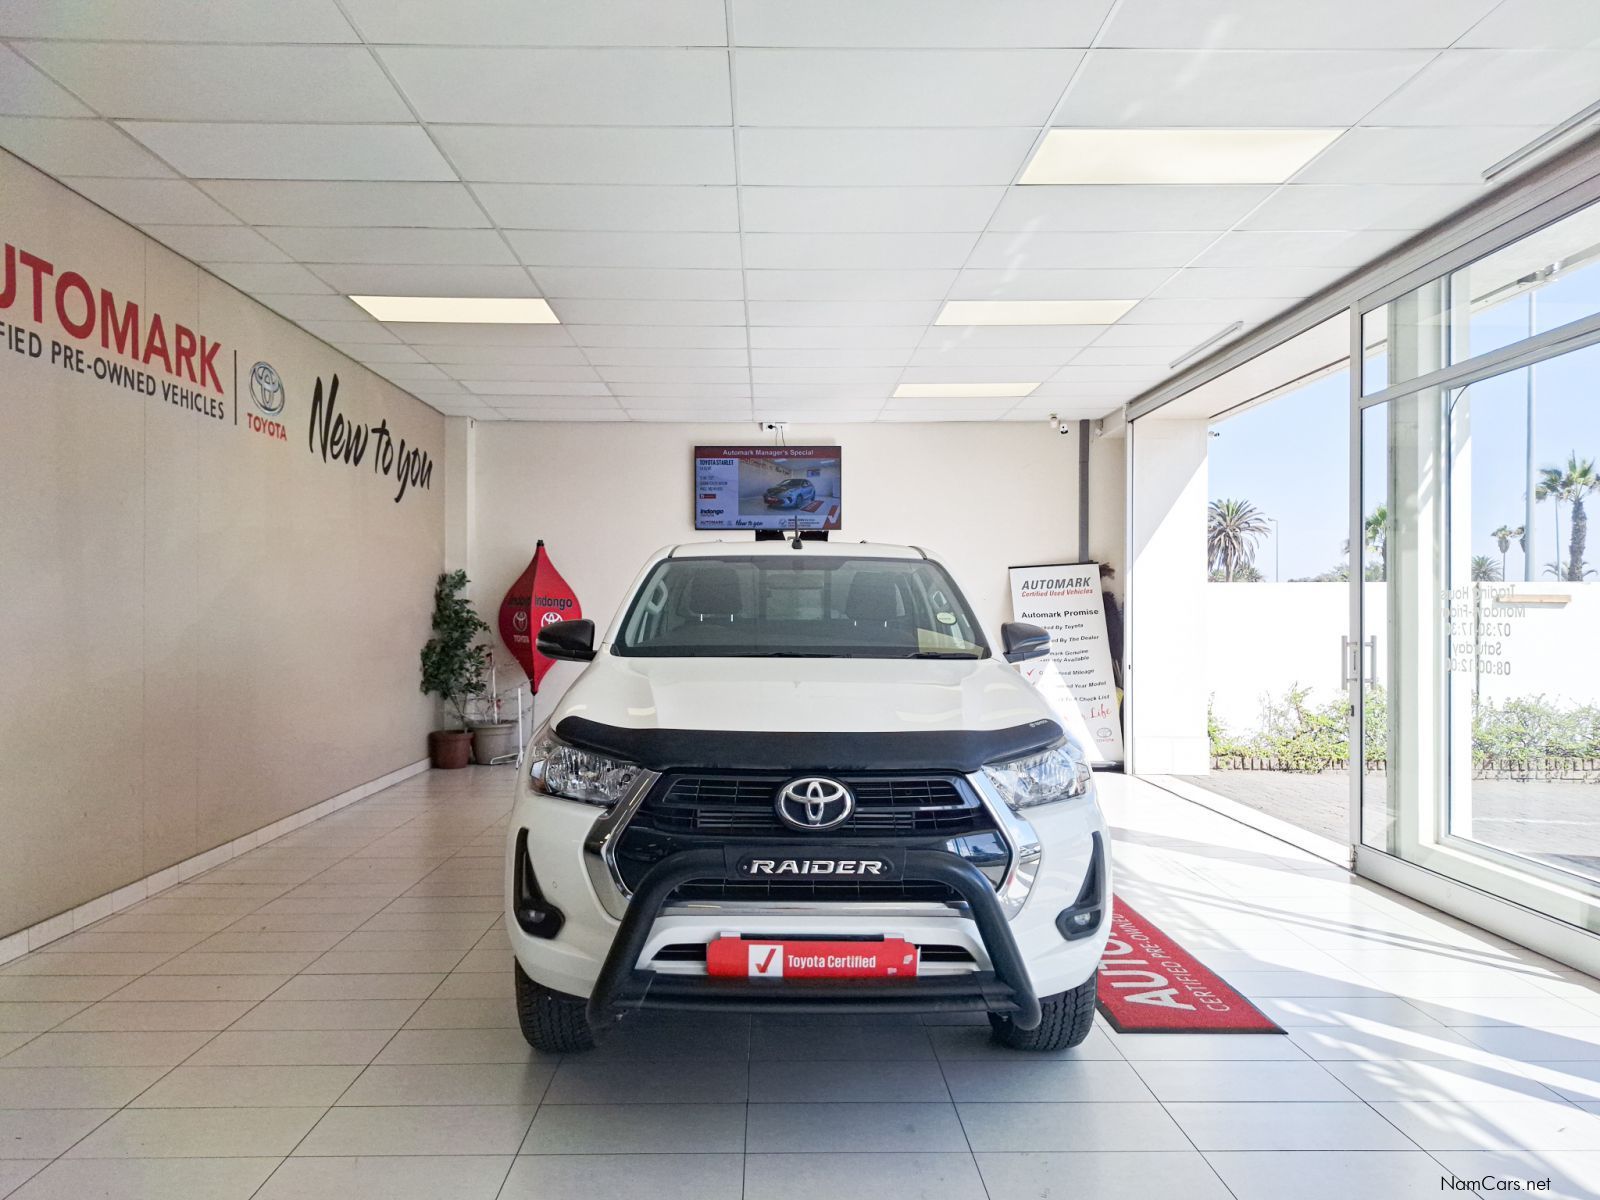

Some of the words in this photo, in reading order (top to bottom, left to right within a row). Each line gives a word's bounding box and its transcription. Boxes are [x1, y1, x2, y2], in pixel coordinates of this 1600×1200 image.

[51, 340, 156, 397] PRE-OWNED
[161, 389, 225, 420] VEHICLES
[247, 412, 288, 442] TOYOTA
[308, 373, 369, 464] New
[371, 418, 394, 476] to
[394, 438, 434, 503] you
[755, 449, 788, 457] Manager's
[1021, 577, 1091, 591] AUTOMARK
[1021, 590, 1049, 598] Certified
[1049, 589, 1065, 597] Used
[1066, 588, 1093, 596] Vehicles
[535, 596, 573, 610] Indongo
[1021, 611, 1061, 619] Automark
[1064, 609, 1099, 617] Promise
[750, 859, 883, 875] RAIDER
[787, 954, 826, 969] Toyota
[827, 954, 877, 969] Certified
[1160, 960, 1231, 1012] CERTIFIED
